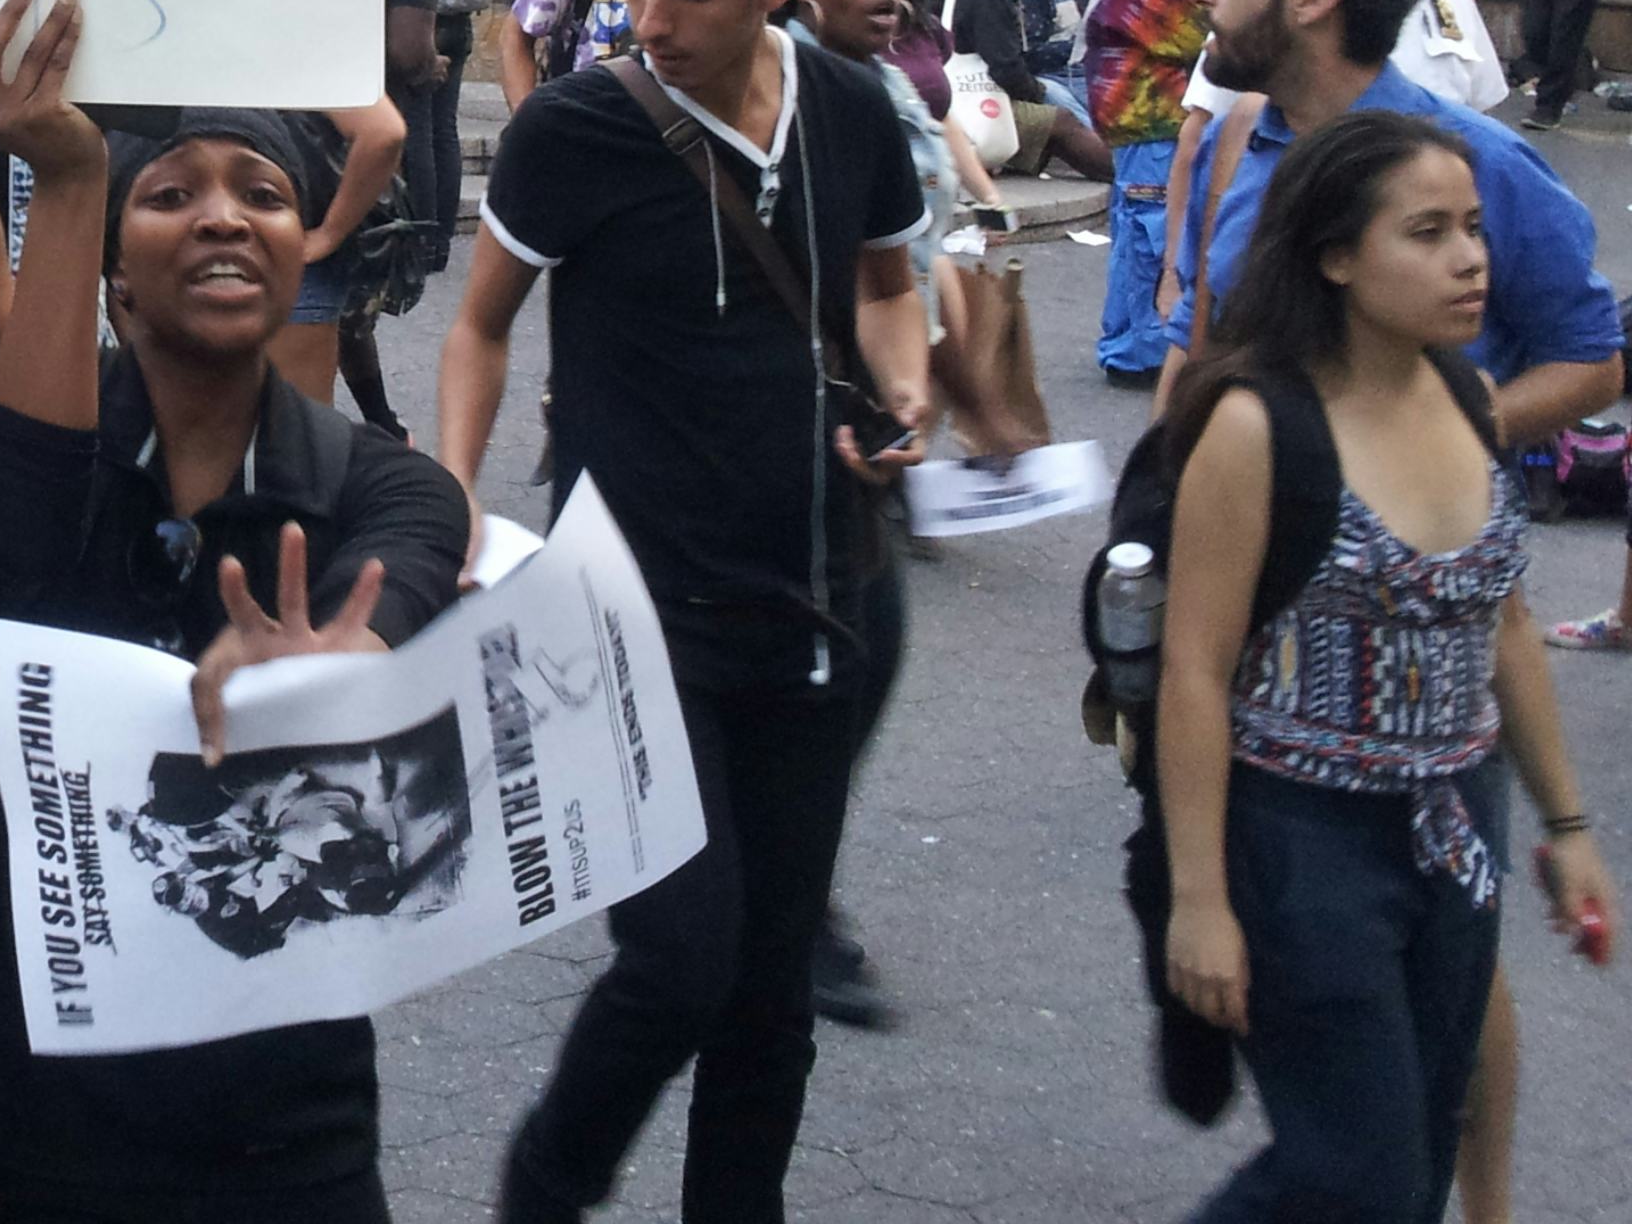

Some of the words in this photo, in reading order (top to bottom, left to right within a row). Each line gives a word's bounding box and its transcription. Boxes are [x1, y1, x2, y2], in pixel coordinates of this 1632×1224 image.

[17, 661, 68, 865] SOMETHING
[63, 769, 107, 901] SOMETHING
[499, 775, 543, 838] THE
[38, 867, 77, 928] SEE
[507, 834, 556, 927] BLOW
[82, 904, 113, 946] SAY
[44, 933, 87, 994] YOU
[55, 999, 95, 1026] IF
